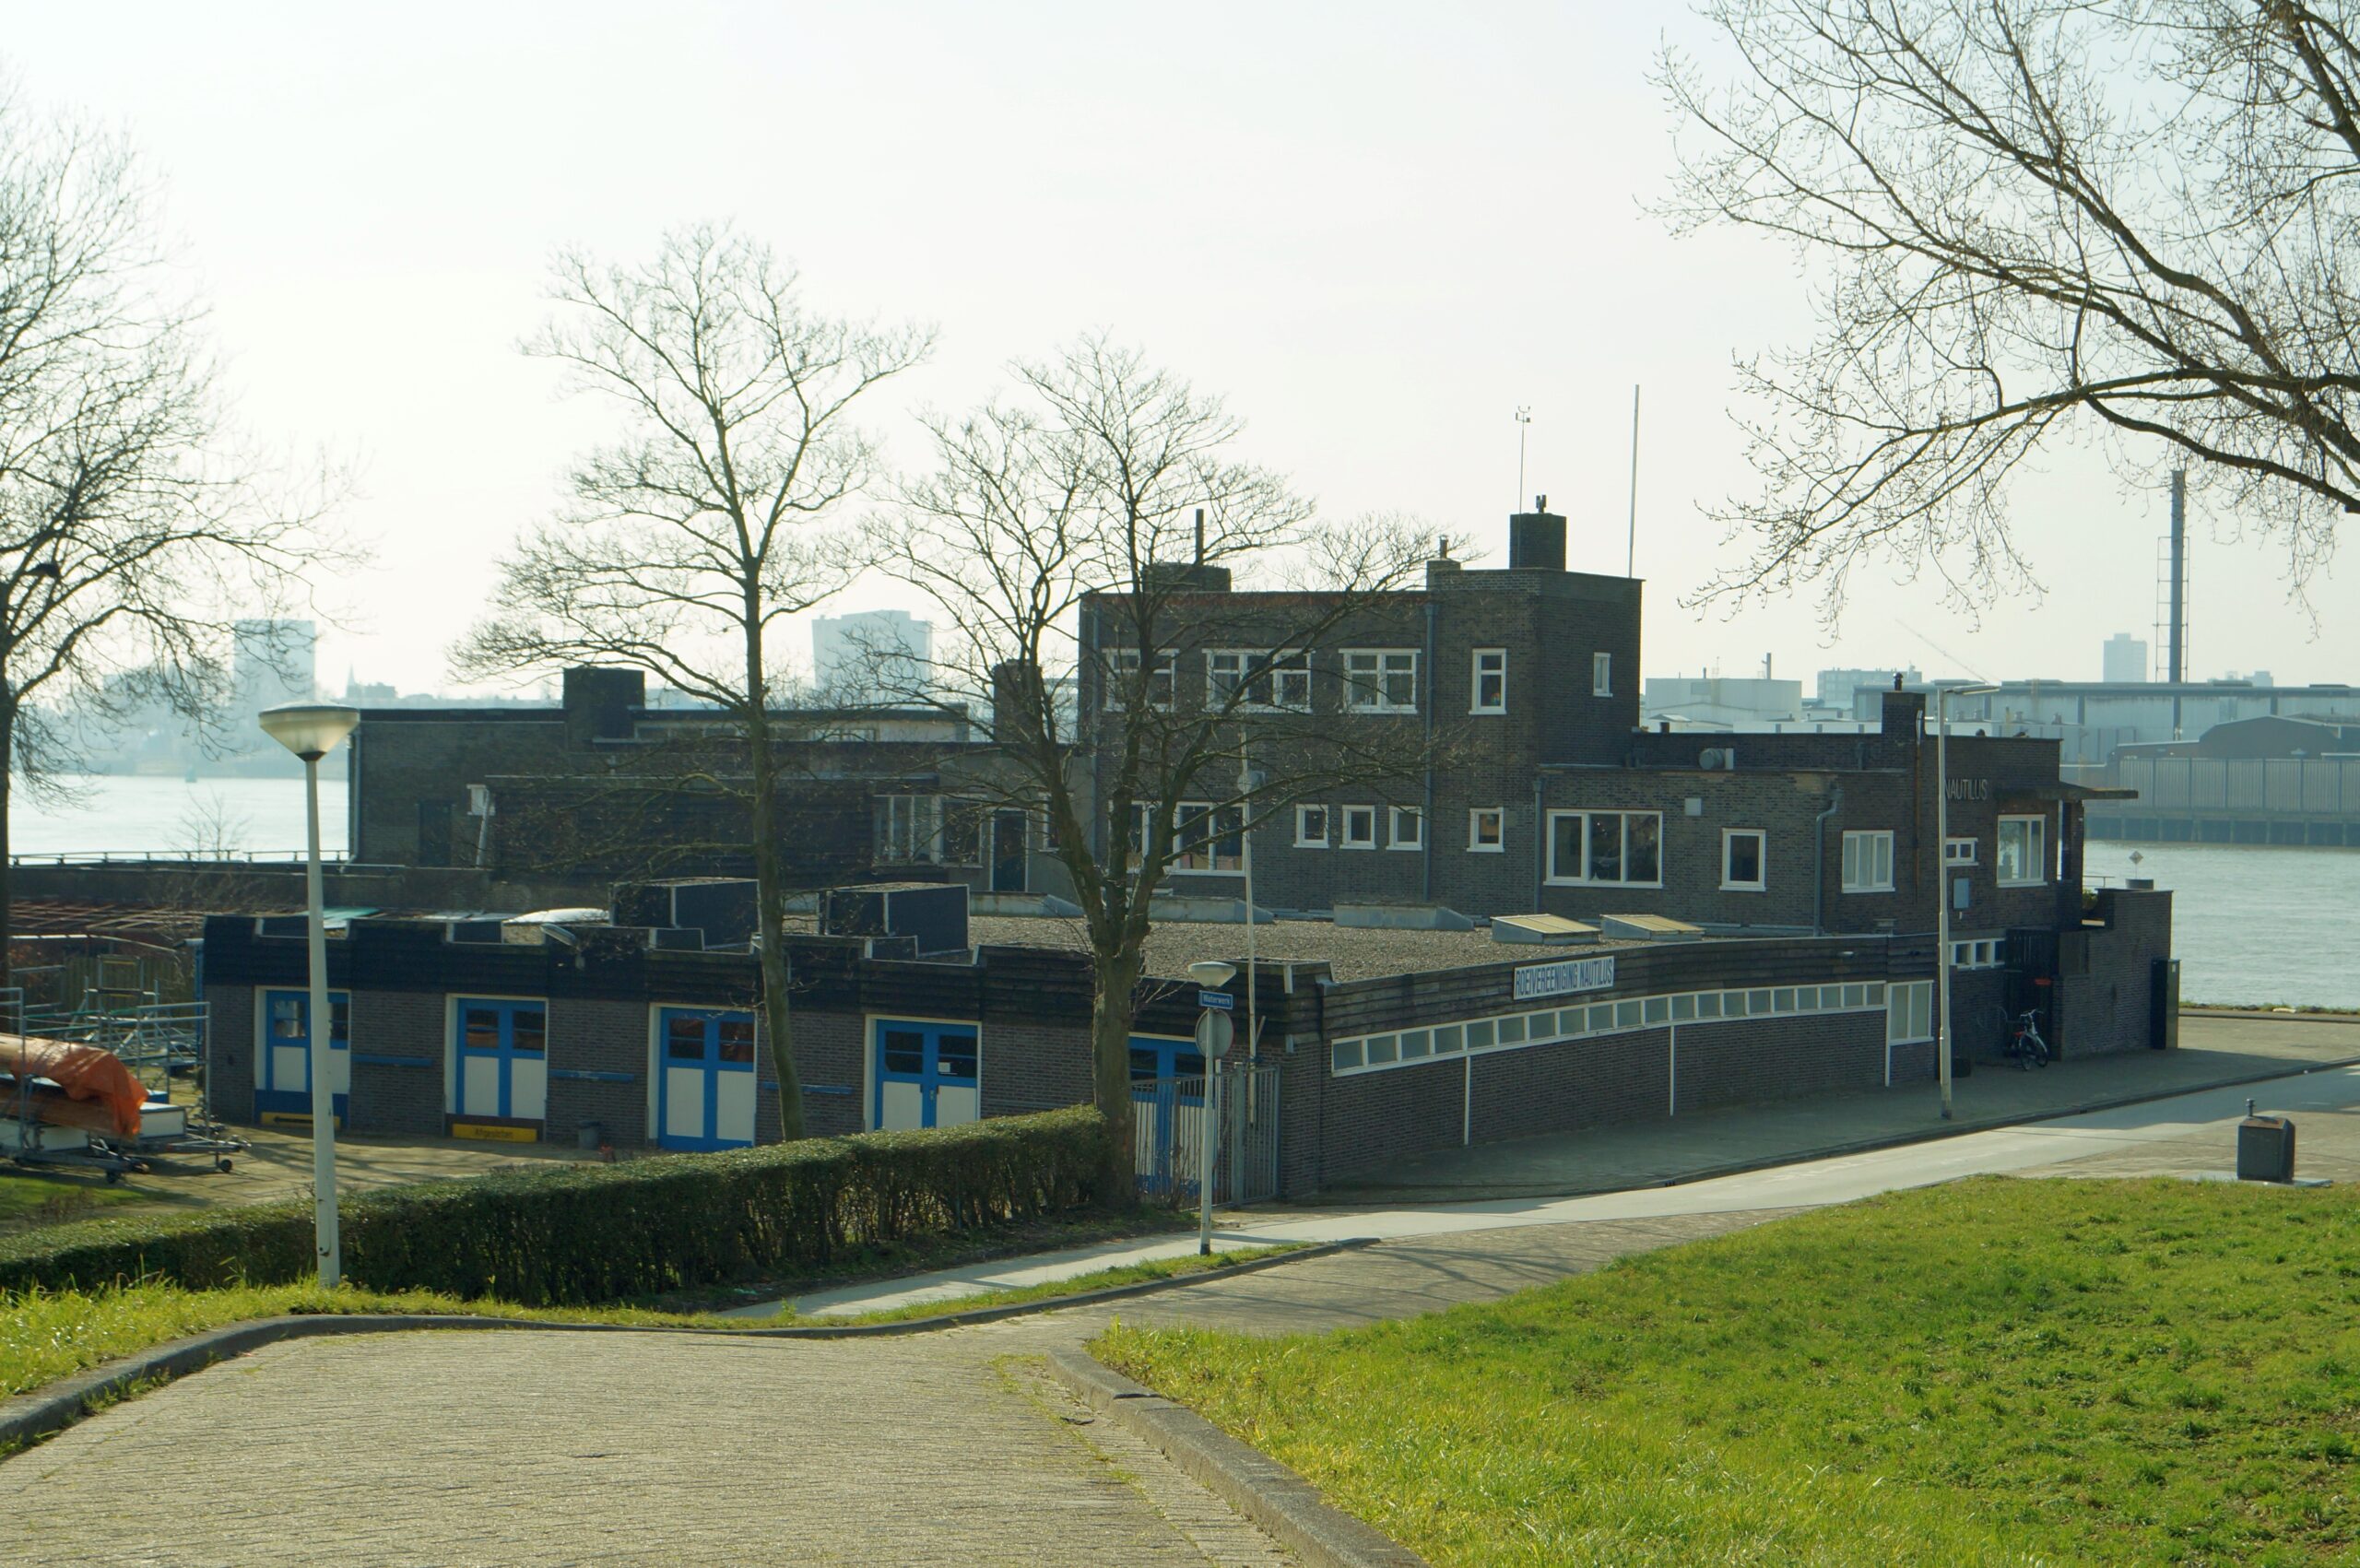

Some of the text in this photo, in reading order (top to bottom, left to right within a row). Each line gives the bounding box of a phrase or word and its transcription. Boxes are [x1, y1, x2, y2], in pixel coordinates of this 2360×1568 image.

[1945, 778, 1988, 800] NAUTILUS
[1516, 959, 1612, 996] ROEIVEREENIGING NAUTILUS
